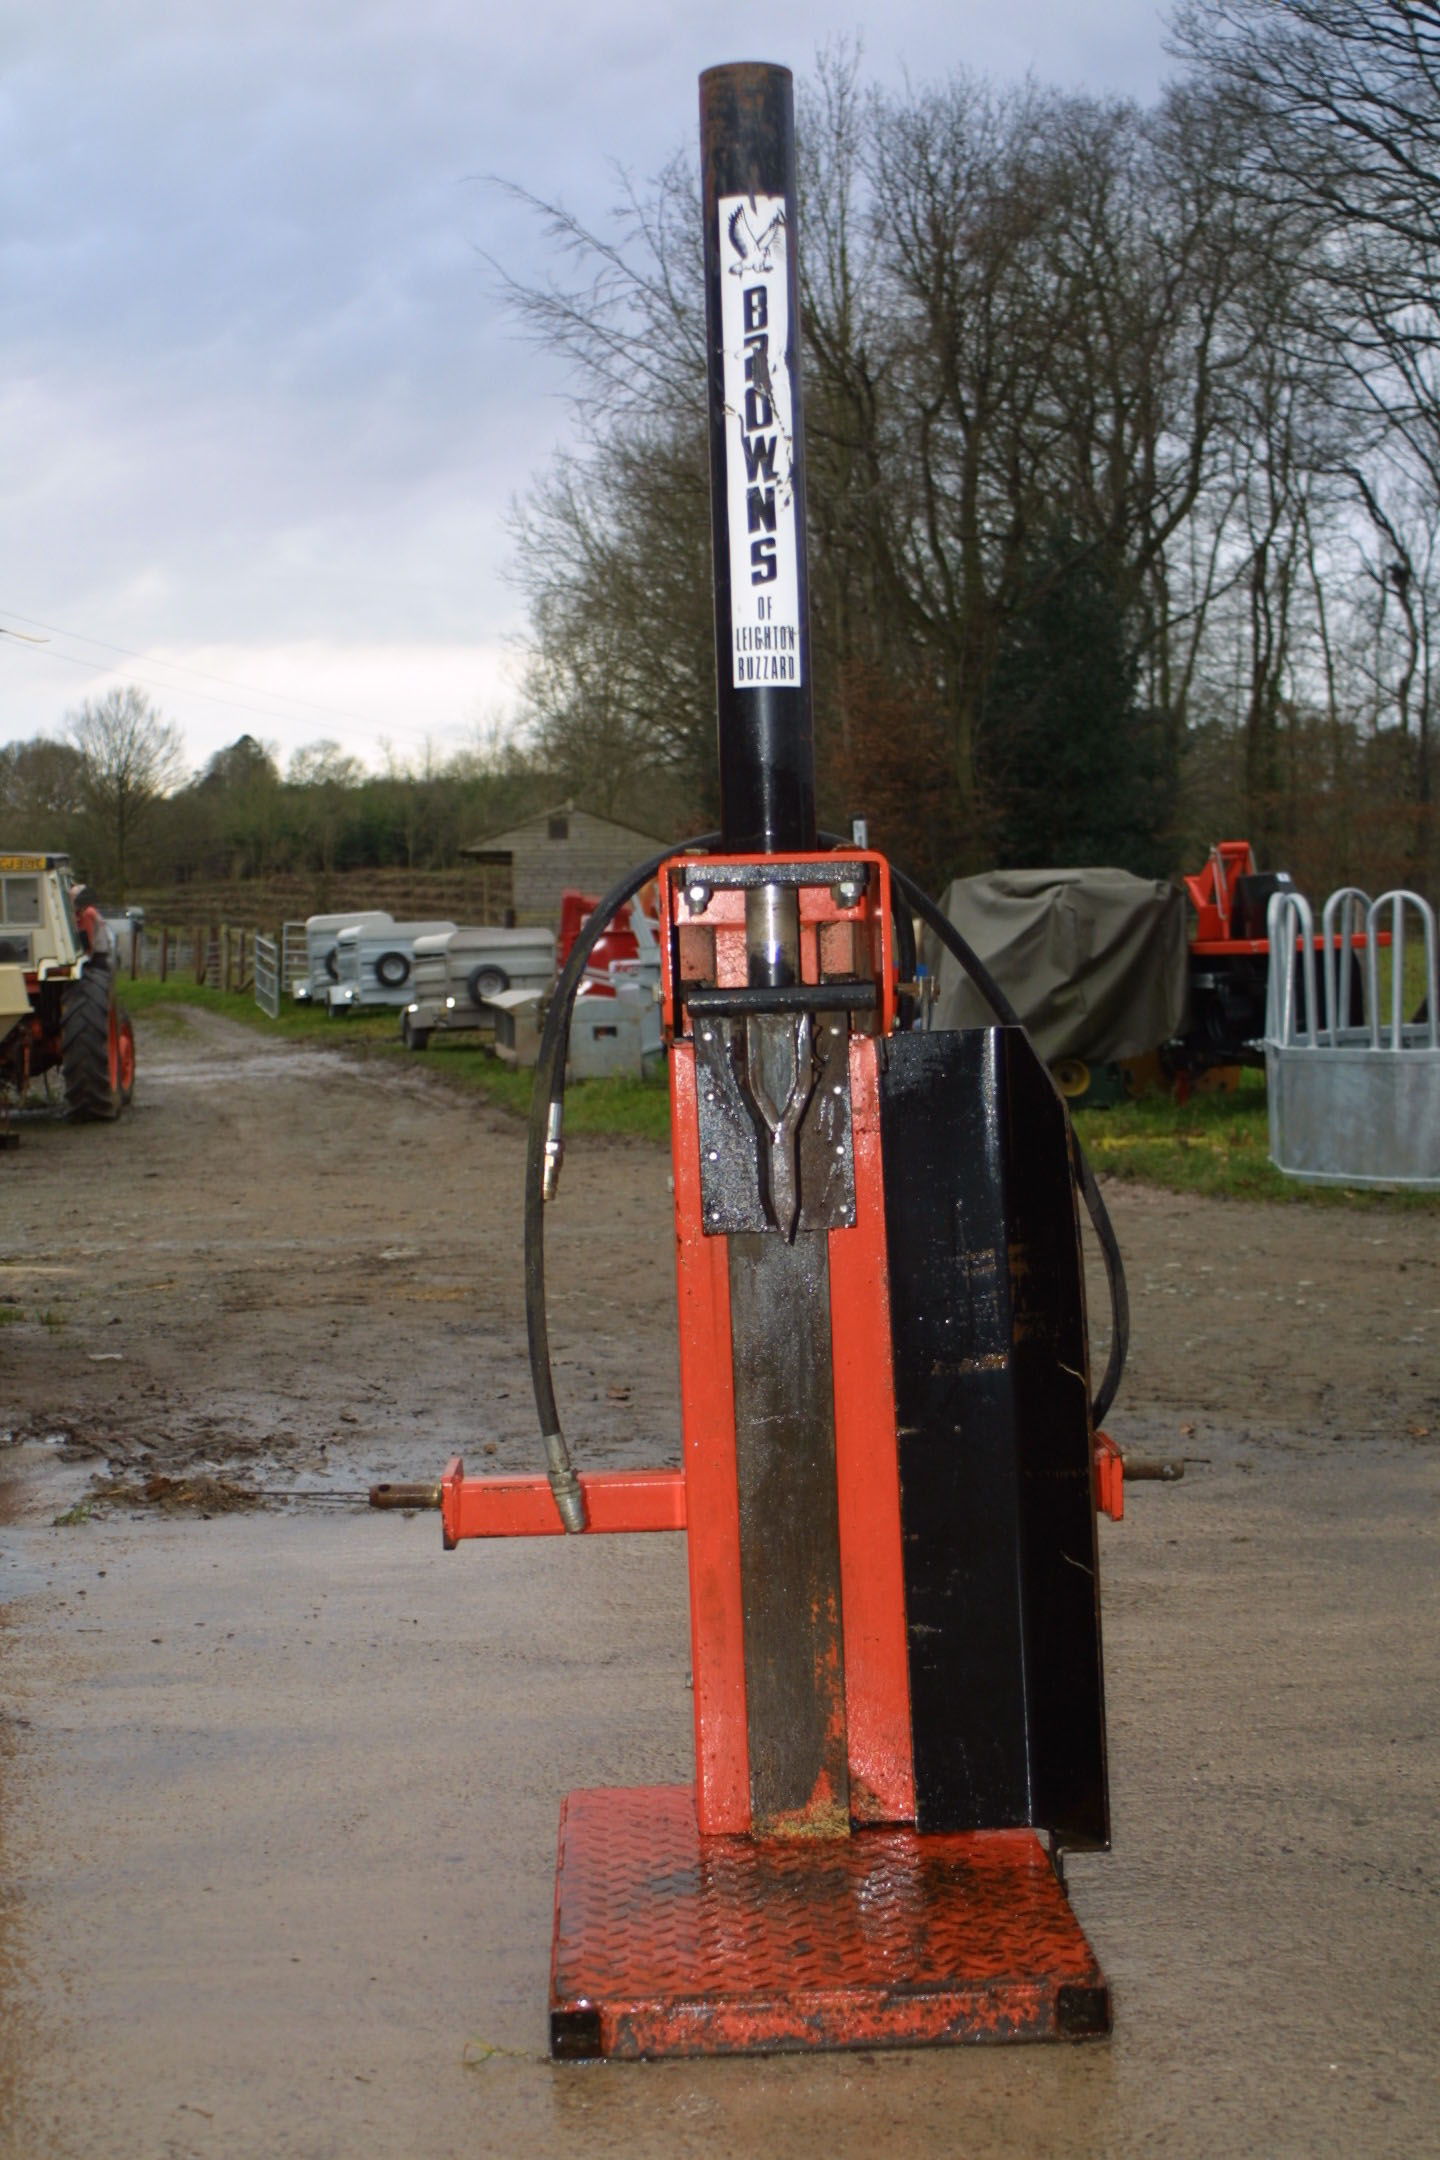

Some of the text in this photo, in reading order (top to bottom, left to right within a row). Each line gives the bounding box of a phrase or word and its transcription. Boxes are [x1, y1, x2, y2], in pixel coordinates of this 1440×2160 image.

[757, 596, 772, 621] OF
[736, 625, 795, 652] LEIGHTON
[738, 655, 795, 681] BUZZARD
